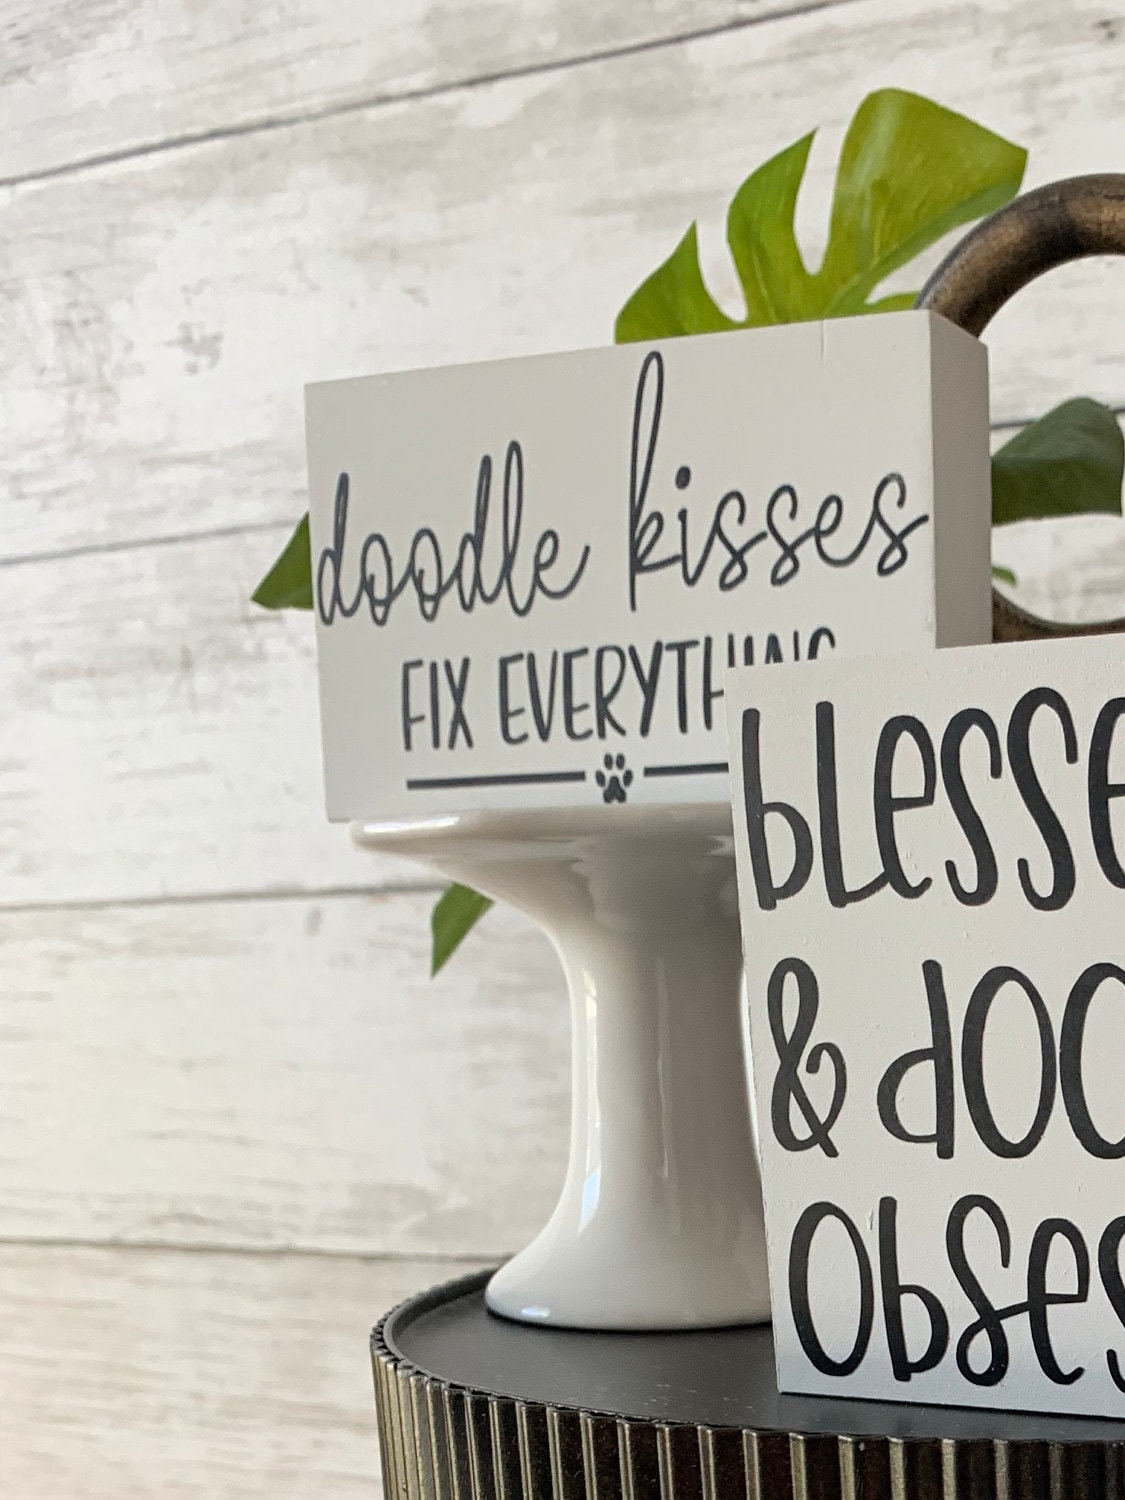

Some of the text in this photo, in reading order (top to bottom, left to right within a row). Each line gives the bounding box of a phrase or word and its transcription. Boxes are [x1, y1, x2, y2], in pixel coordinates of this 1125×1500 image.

[317, 351, 930, 627] doodle kisses
[401, 656, 473, 752] FIX
[768, 957, 848, 1158] &
